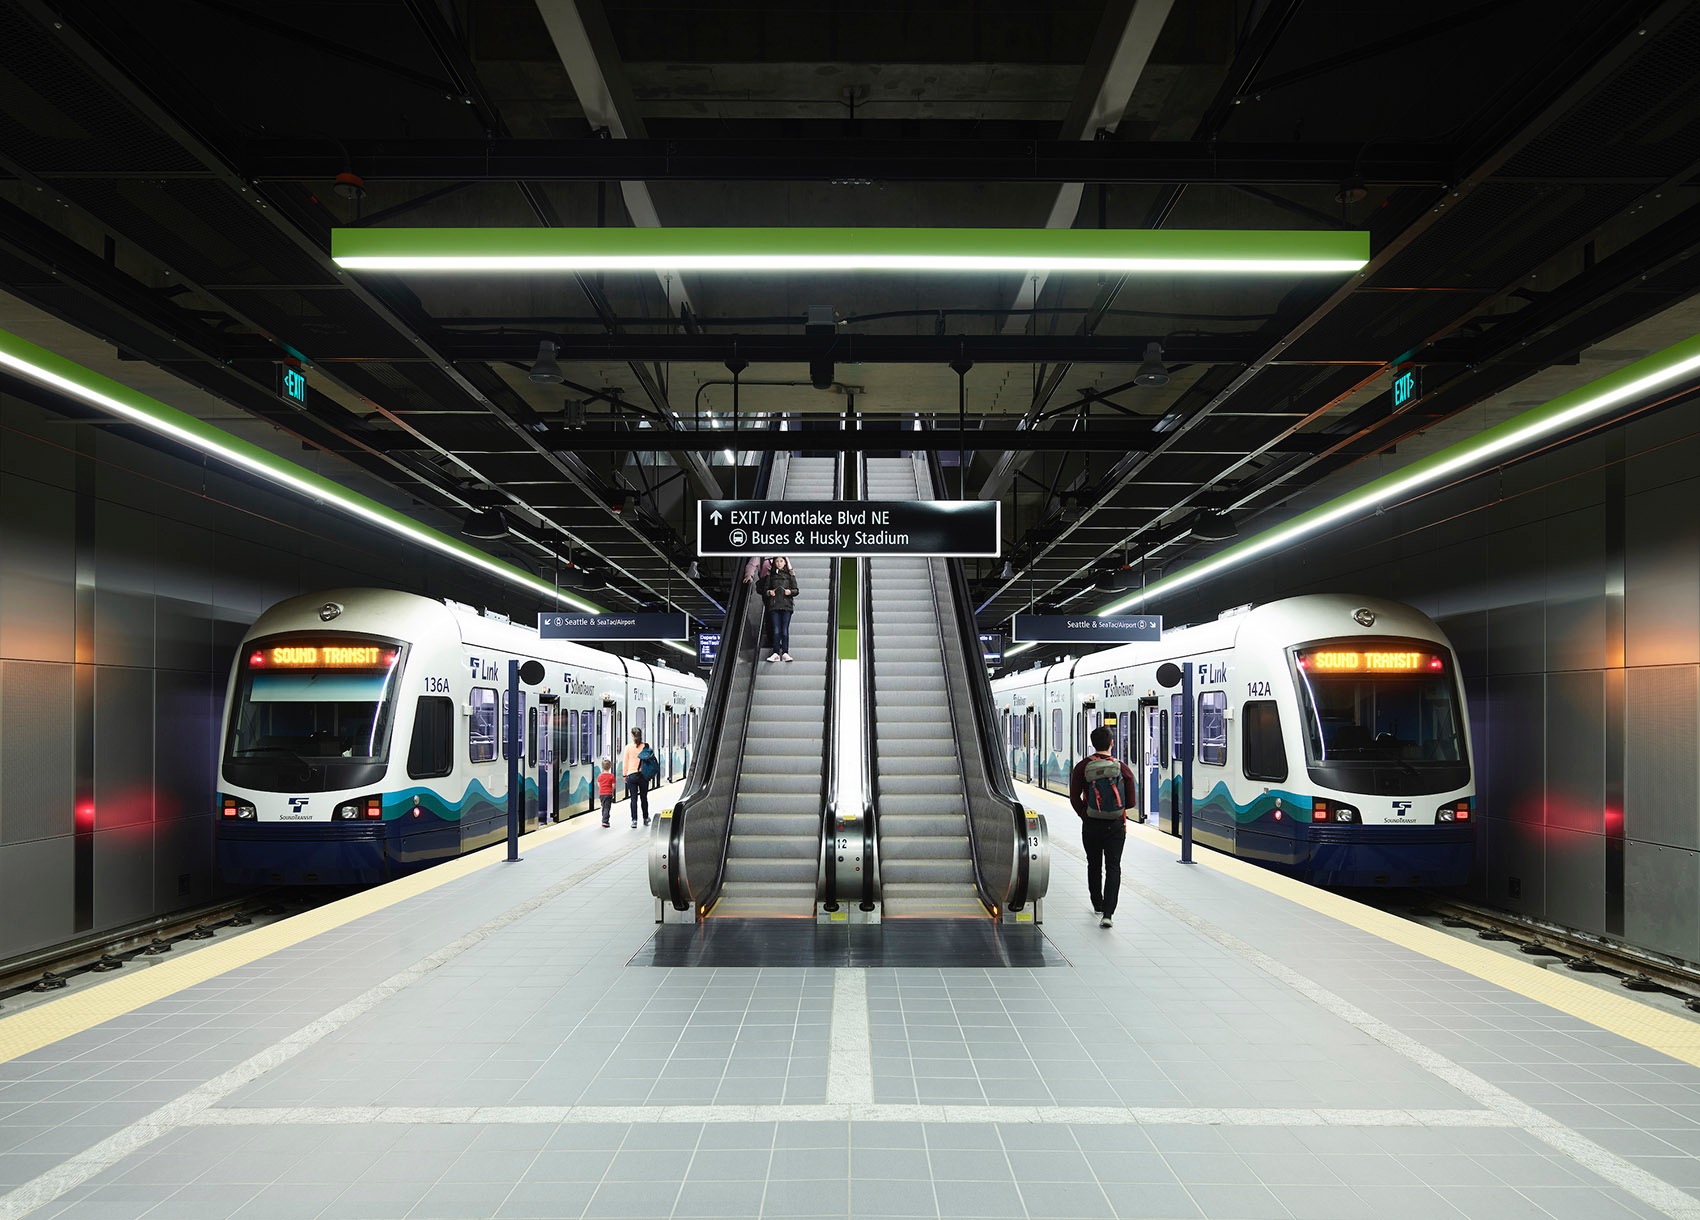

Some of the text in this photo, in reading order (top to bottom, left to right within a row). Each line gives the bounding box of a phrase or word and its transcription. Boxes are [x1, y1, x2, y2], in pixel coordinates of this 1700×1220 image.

[289, 369, 305, 402] EXIT
[1395, 372, 1411, 406] EXIT
[838, 510, 866, 525] Blvd
[871, 511, 890, 525] NE
[752, 530, 909, 548] Buses & Husky Stadium
[565, 618, 588, 626] Seattle
[590, 618, 596, 626] &
[1067, 620, 1091, 629] Seattle
[1092, 620, 1098, 629] &
[273, 647, 379, 664] SOUND TRANSIT
[1316, 652, 1420, 669] SOUND TRANSIT
[481, 659, 499, 682] Link
[1209, 661, 1227, 684] Link
[424, 677, 450, 693] 136A
[1247, 681, 1272, 697] 142A
[837, 838, 848, 849] 12
[1028, 837, 1039, 847] 13
